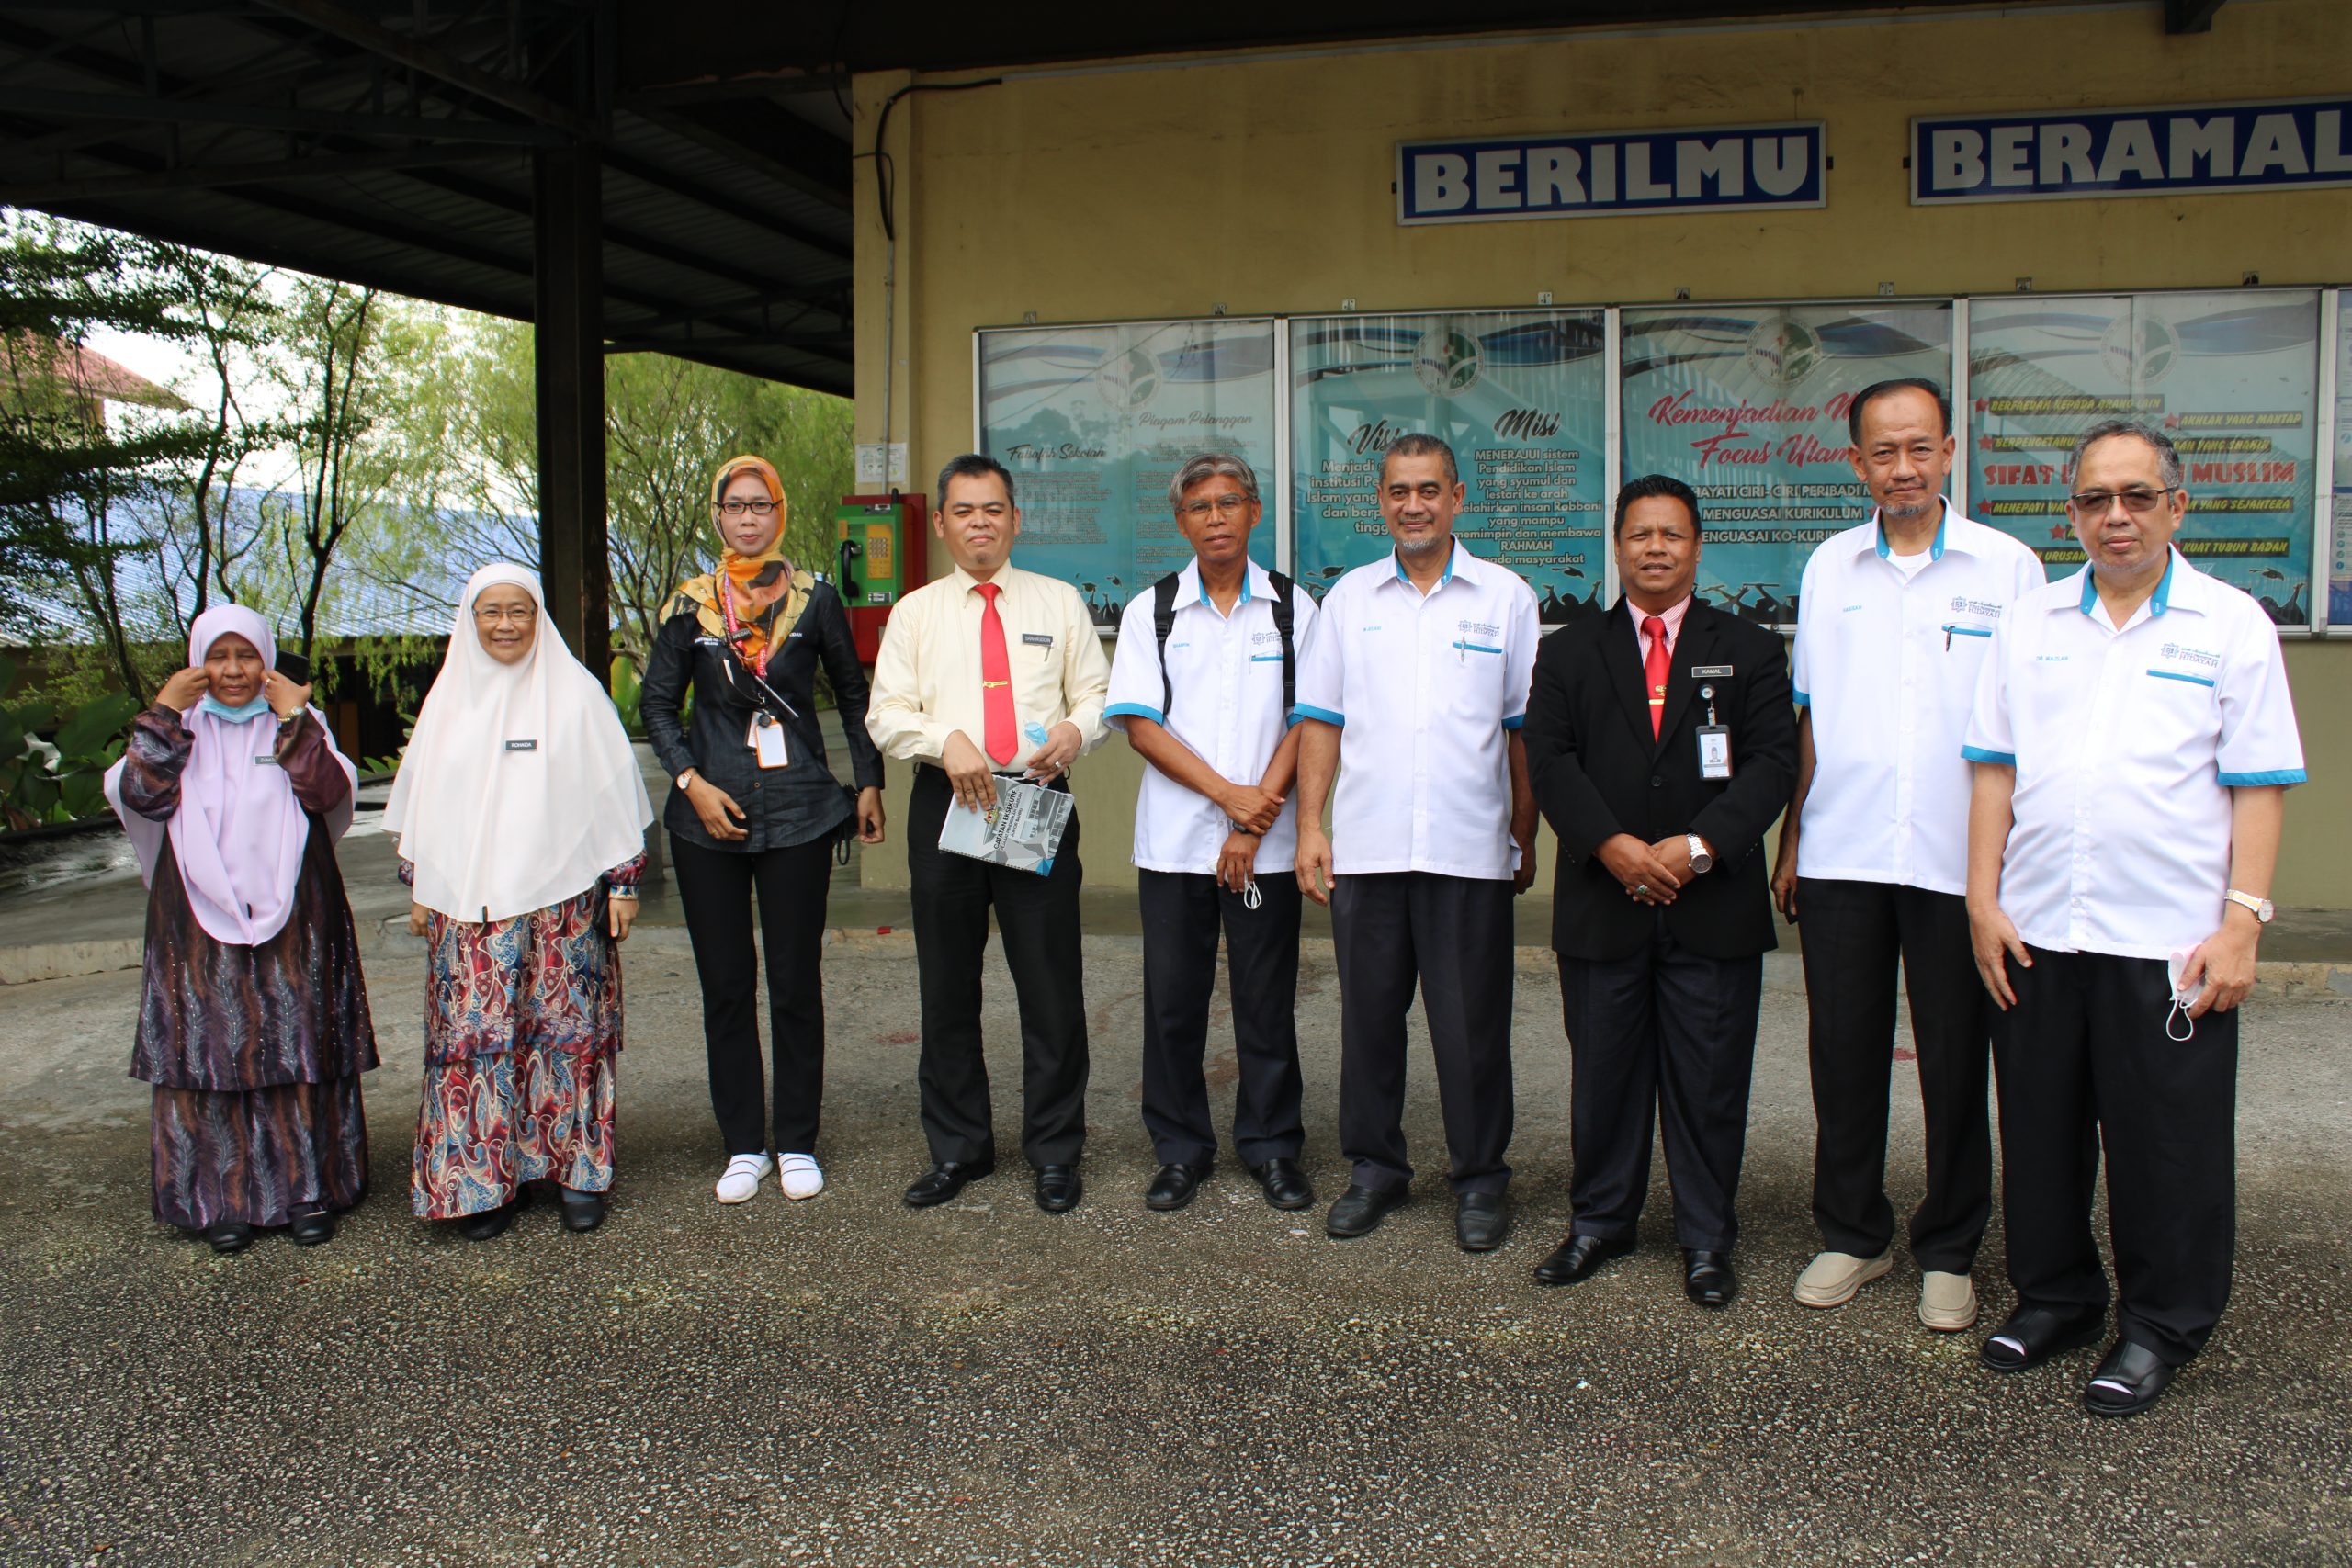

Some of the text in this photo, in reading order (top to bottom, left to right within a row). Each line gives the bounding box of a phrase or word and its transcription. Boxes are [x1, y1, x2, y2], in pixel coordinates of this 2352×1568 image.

[1932, 109, 2352, 190] BERAMAL
[1415, 135, 1808, 212] BERILMU
[1648, 389, 1818, 433] Kemenjadian
[1991, 400, 2052, 412] BERFAEDAH
[2054, 399, 2096, 410] KEPADA
[2136, 397, 2162, 408] LAIN
[1188, 410, 1252, 429] Pelanggan
[1494, 408, 1560, 442] Misi
[2181, 412, 2302, 426] AKHLAK YANG MANTAP
[1995, 435, 2076, 448] BERPENGETAHU
[2198, 440, 2227, 451] YANG
[1059, 443, 1105, 460] Sekolah
[1475, 449, 1579, 461] MENERAJUI sistem
[1690, 432, 1849, 469] Focus Ulam
[1322, 460, 1374, 474] Menjadi
[1478, 461, 1576, 474] Pendidikan Islam
[2192, 461, 2295, 484] MUSLIM
[1311, 476, 1361, 488] institusi
[1984, 464, 2054, 486] SIFAT
[1477, 475, 1576, 491] yang syumul dan
[1306, 491, 1377, 505] Islam yang
[1486, 487, 1568, 500] lestari ke arah
[1695, 486, 1737, 498] HAYATI
[1802, 484, 1860, 497] PERIBADI
[1323, 506, 1348, 518] dan
[1520, 501, 1555, 512] insan
[1554, 499, 1602, 512] Rabbani
[1993, 502, 2045, 513] MENEPATI
[2199, 499, 2228, 511] YANG
[2230, 499, 2290, 511] SEJAHTERA
[1702, 506, 1863, 520] MENGUASAI KURIKULUM
[1488, 514, 1565, 528] yang mampu
[1354, 522, 1390, 536] tingg
[1455, 525, 1601, 540] memimpin dan membawa
[1702, 530, 1769, 543] ENGUASAI
[1500, 539, 1554, 551] RAHMAH
[2183, 542, 2289, 553] KUAT TUBUH BADAN
[1515, 553, 1584, 566] masyarakat
[2044, 551, 2089, 562] URUSAN
[2178, 651, 2220, 669] HIDAYAH
[993, 789, 1017, 850] CATATAN EKSEKUTIF
